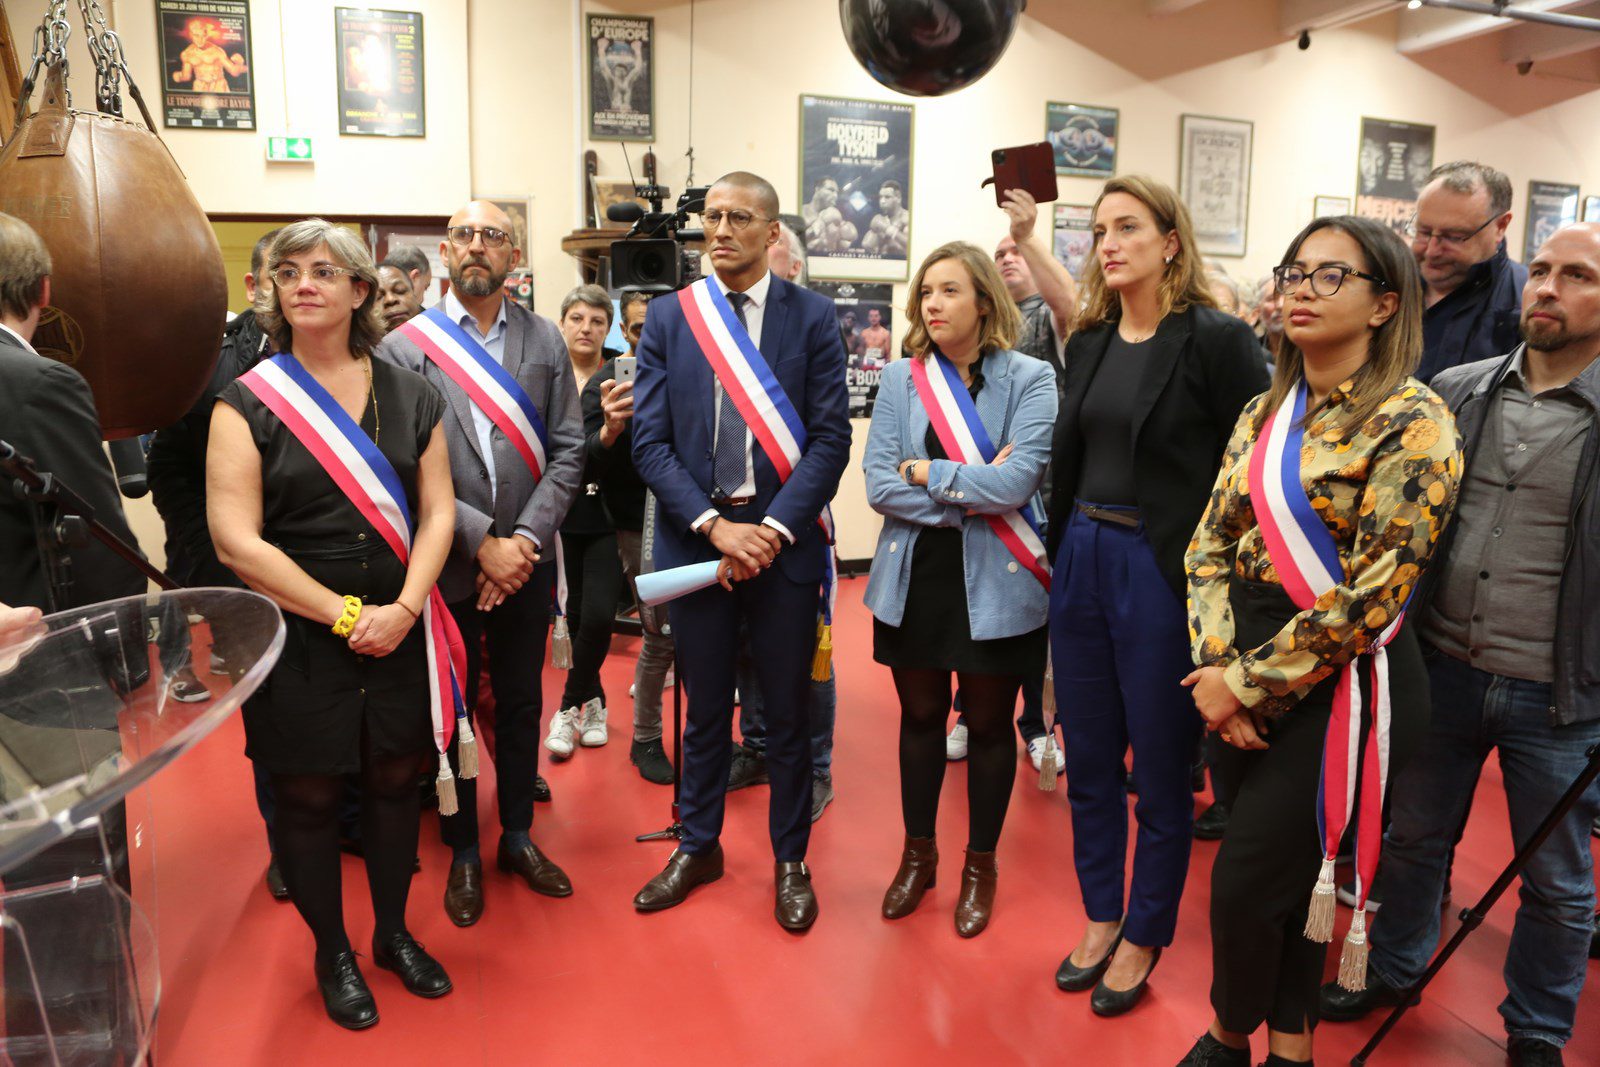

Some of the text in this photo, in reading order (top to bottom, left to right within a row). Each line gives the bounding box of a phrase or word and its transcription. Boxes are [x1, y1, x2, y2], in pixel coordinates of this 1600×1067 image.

[591, 18, 648, 29] CHAMPIONNAT
[827, 122, 889, 144] HOLYFIELD
[838, 138, 878, 158] TYSON
[644, 491, 657, 561] anfrotto
